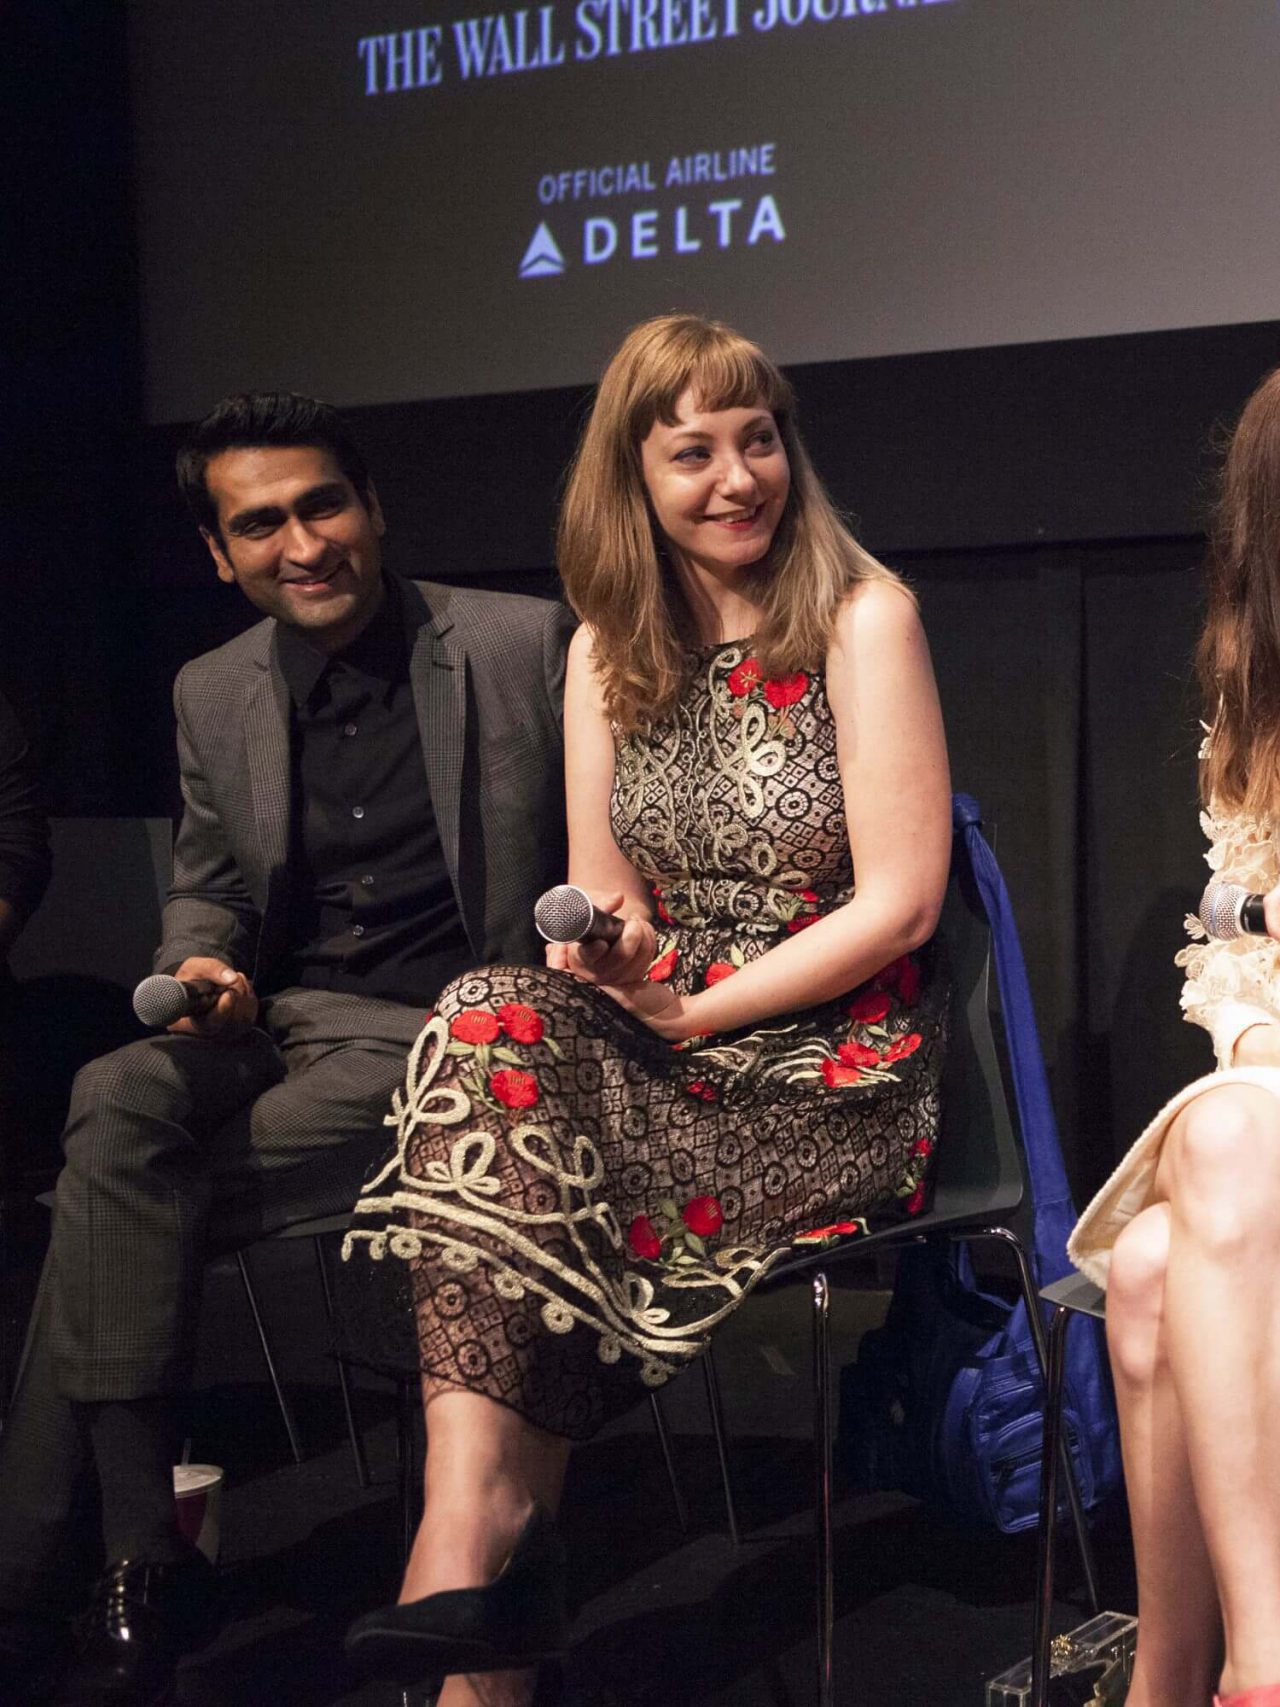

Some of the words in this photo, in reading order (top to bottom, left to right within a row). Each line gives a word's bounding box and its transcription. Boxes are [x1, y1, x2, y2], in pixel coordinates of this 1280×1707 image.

[357, 24, 442, 96] THE
[451, 6, 565, 80] WALL
[575, 0, 739, 61] STREET
[537, 162, 656, 205] OFFICIAL
[665, 143, 776, 187] AIRLINE
[584, 194, 786, 265] DELTA
